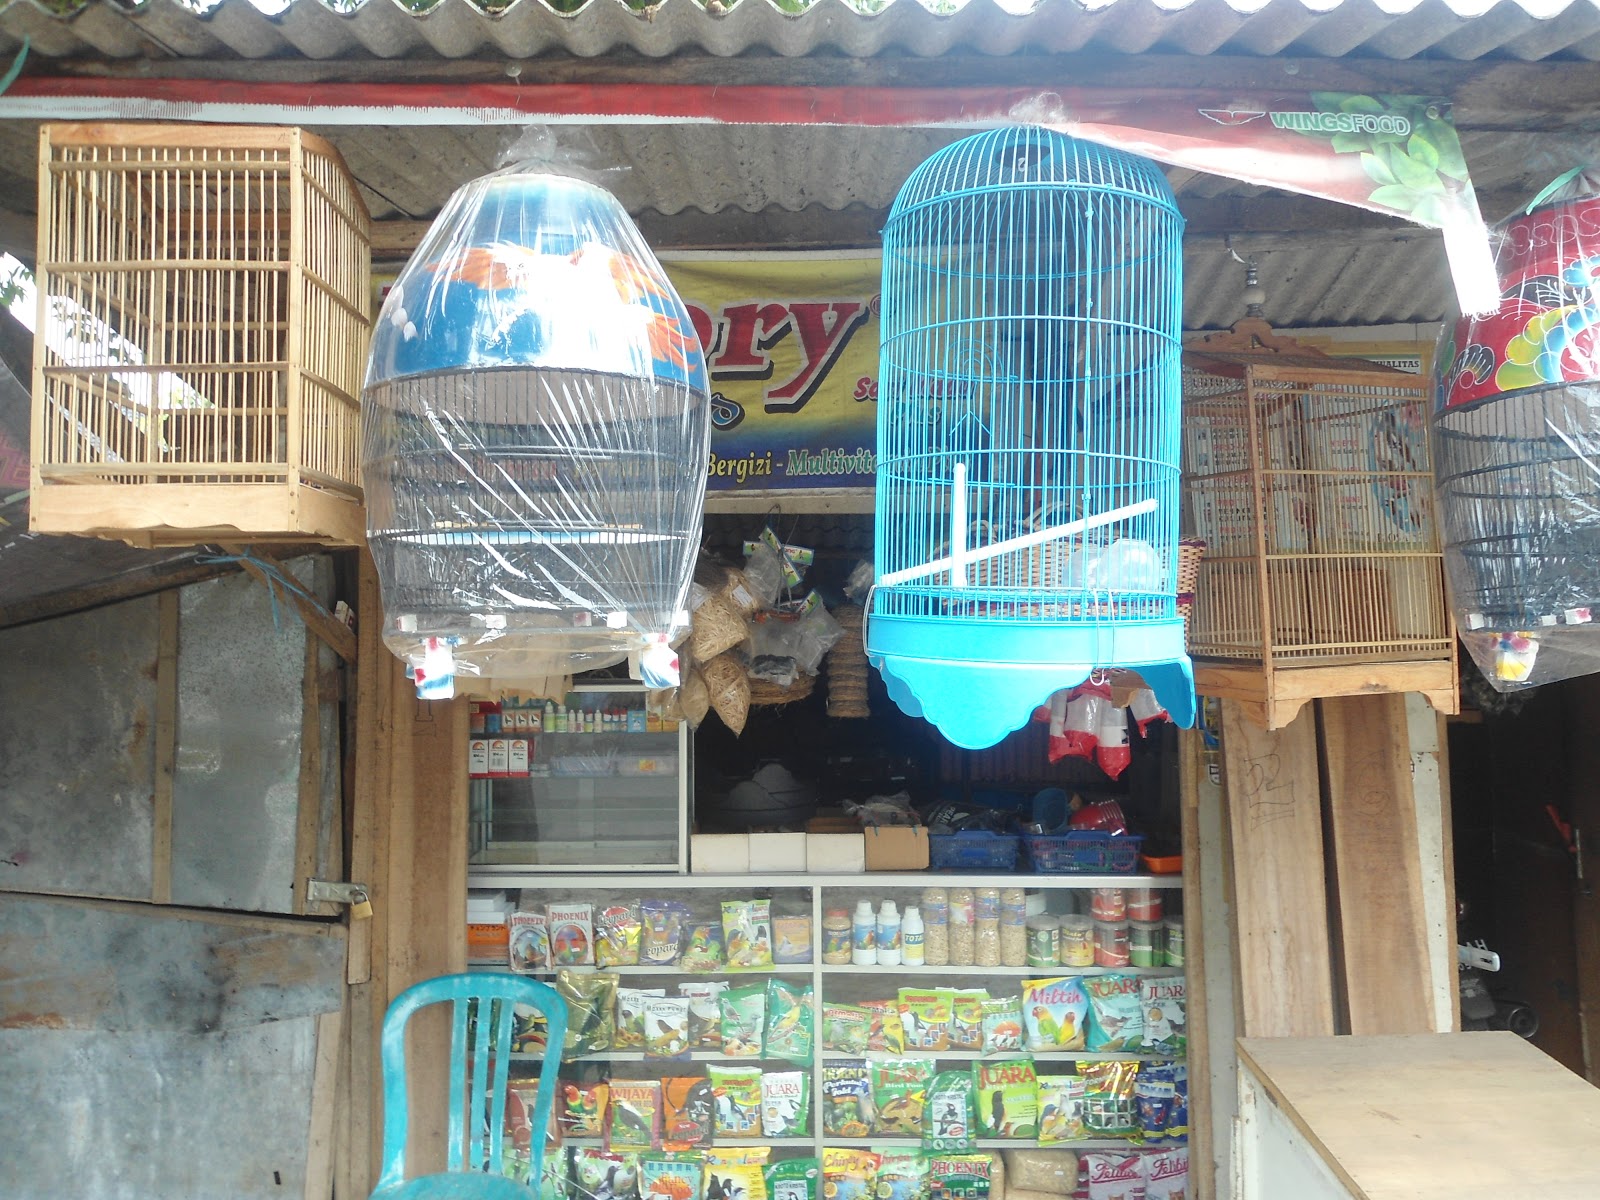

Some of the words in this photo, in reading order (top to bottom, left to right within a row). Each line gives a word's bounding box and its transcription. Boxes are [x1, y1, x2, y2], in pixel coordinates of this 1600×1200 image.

[1269, 111, 1411, 136] WINGSFOOD
[551, 911, 590, 921] PHOENIX
[1149, 984, 1185, 1000] JUAR
[980, 1066, 1035, 1090] JUARA
[610, 1087, 653, 1100] WIJAYA
[765, 1083, 800, 1097] JUARA
[932, 1161, 989, 1178] PHOENIX
